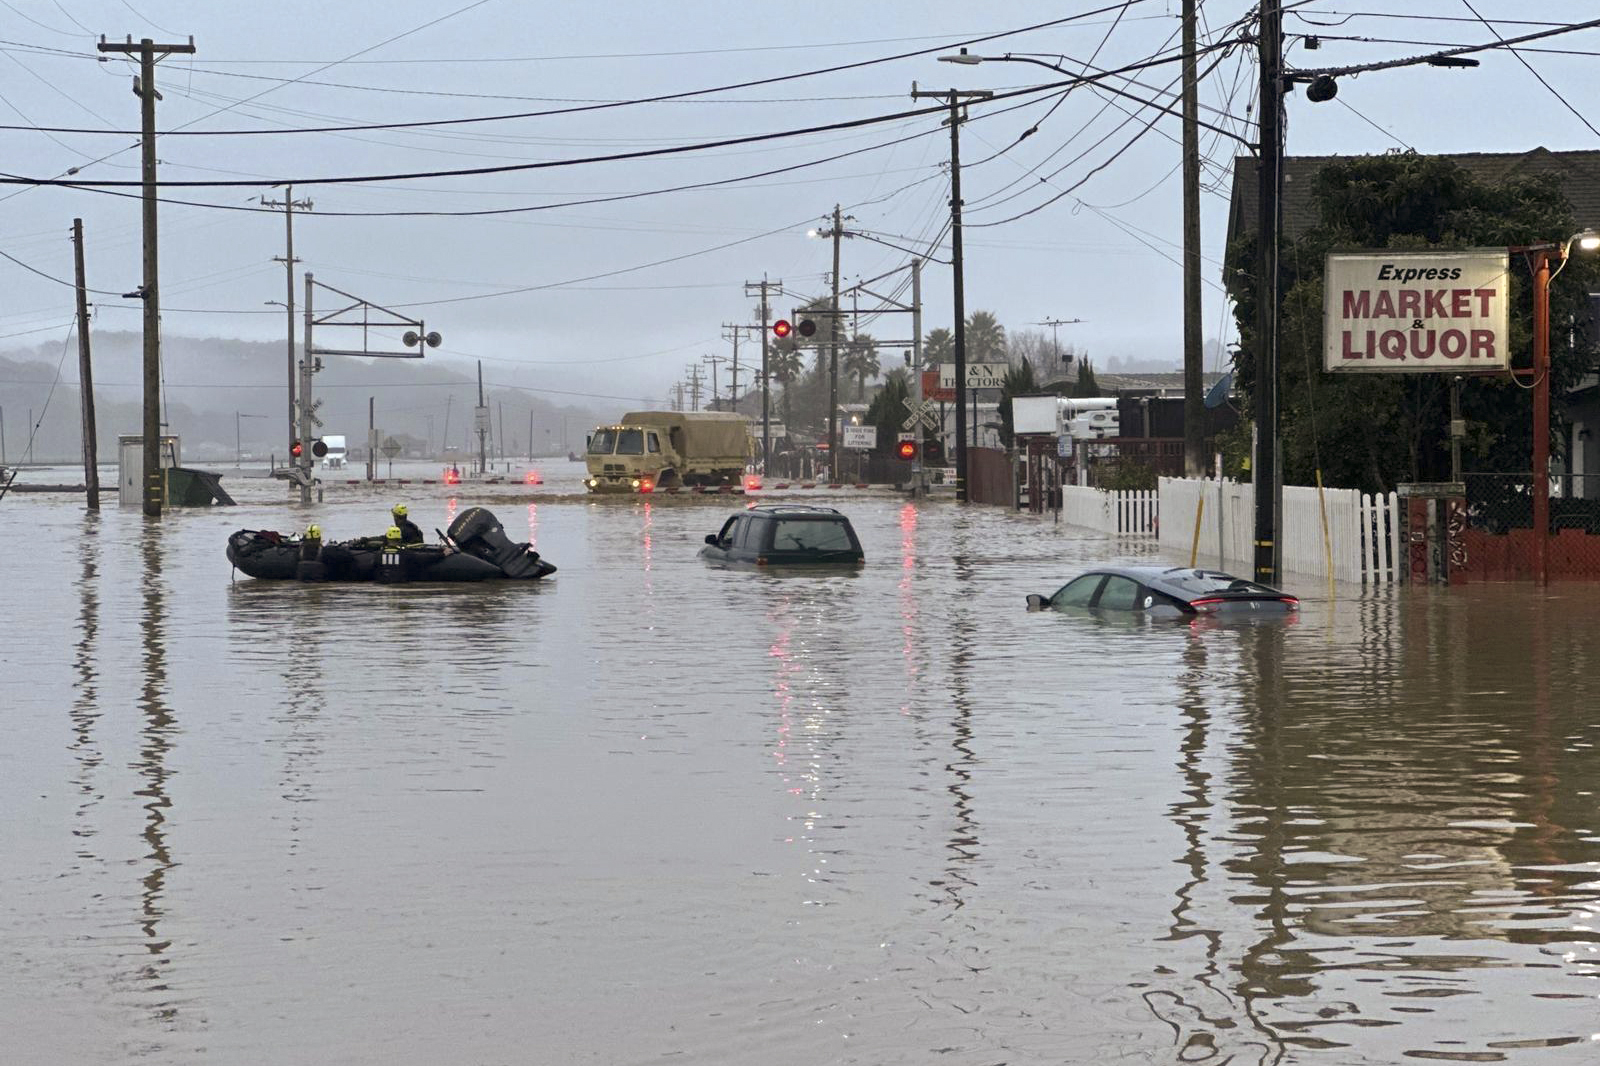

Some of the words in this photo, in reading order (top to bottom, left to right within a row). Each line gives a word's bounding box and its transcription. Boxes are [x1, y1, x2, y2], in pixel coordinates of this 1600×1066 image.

[1377, 264, 1462, 284] Express
[1342, 289, 1496, 319] MARKET
[1412, 319, 1425, 329] &
[1342, 329, 1496, 361] LIQUOR
[968, 365, 980, 376] &
[982, 365, 994, 377] N
[943, 377, 1008, 388] TCTORS
